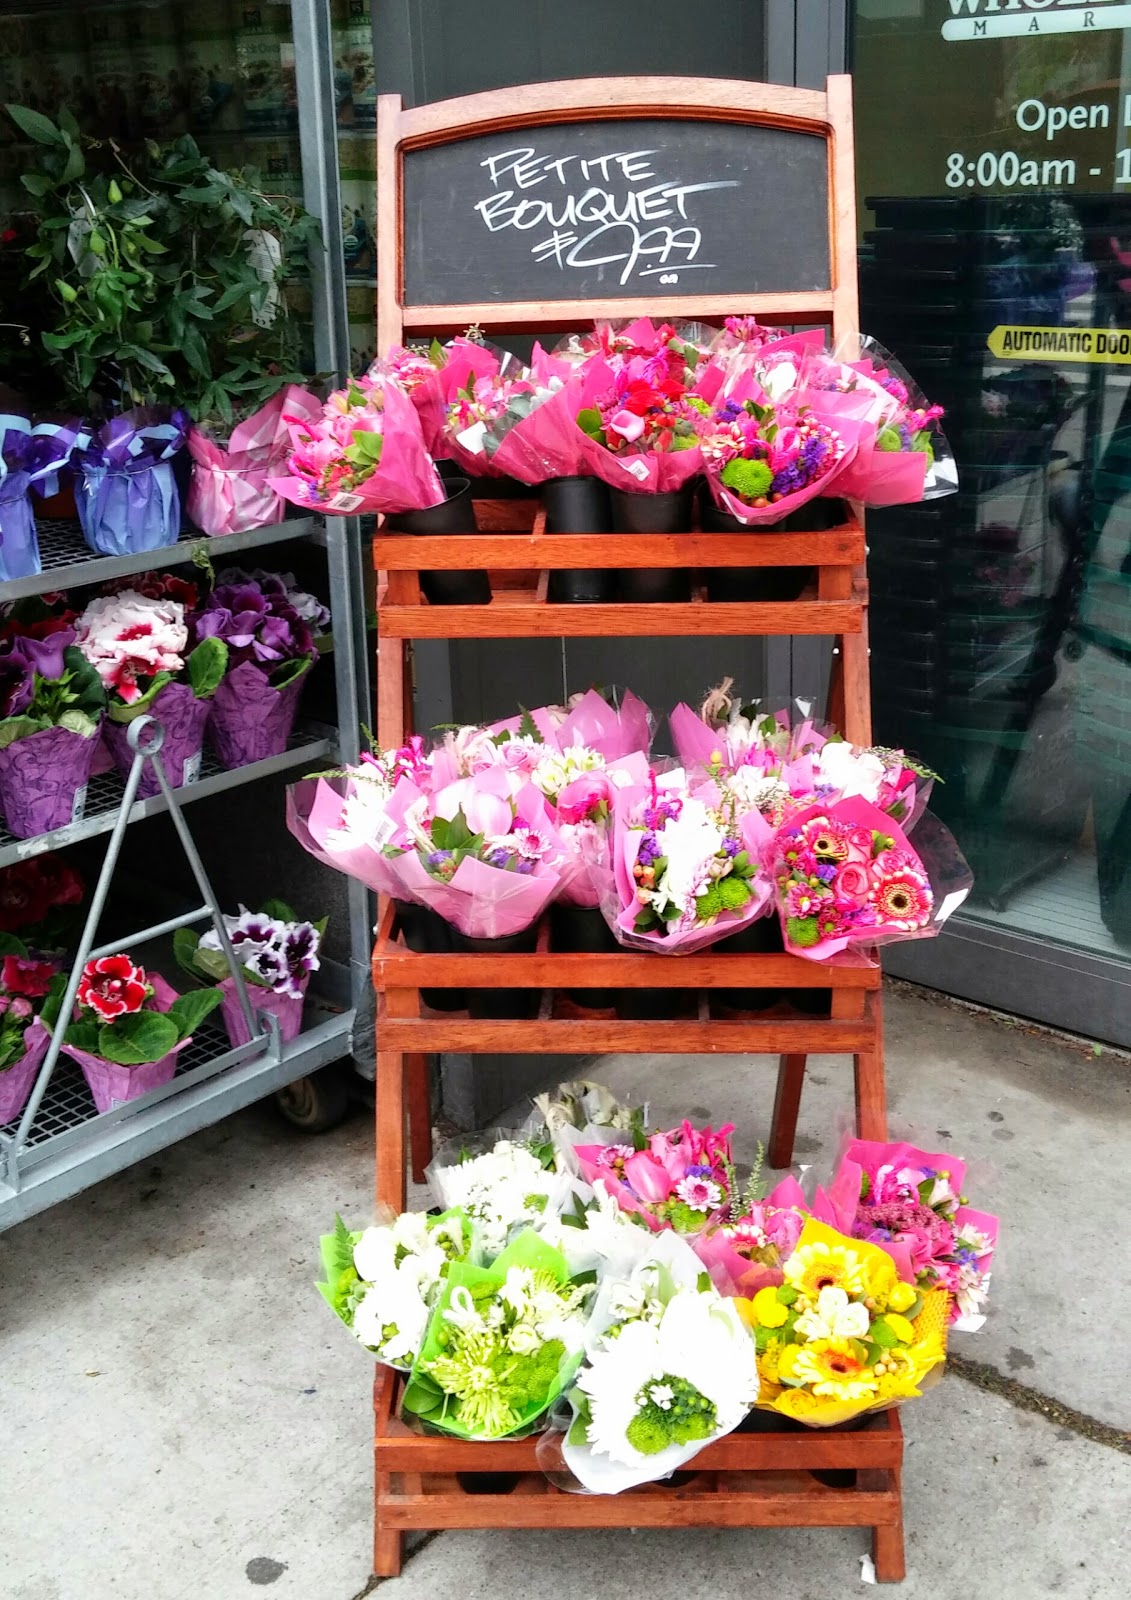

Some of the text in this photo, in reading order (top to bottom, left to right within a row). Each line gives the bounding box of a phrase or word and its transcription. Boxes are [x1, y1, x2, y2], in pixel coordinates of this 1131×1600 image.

[1016, 99, 1110, 141] Open
[480, 147, 660, 189] PETITE
[945, 151, 1076, 188] 8:00am
[474, 180, 742, 232] BOUQUET
[1002, 330, 1131, 355] AUTOMATIC DOO
